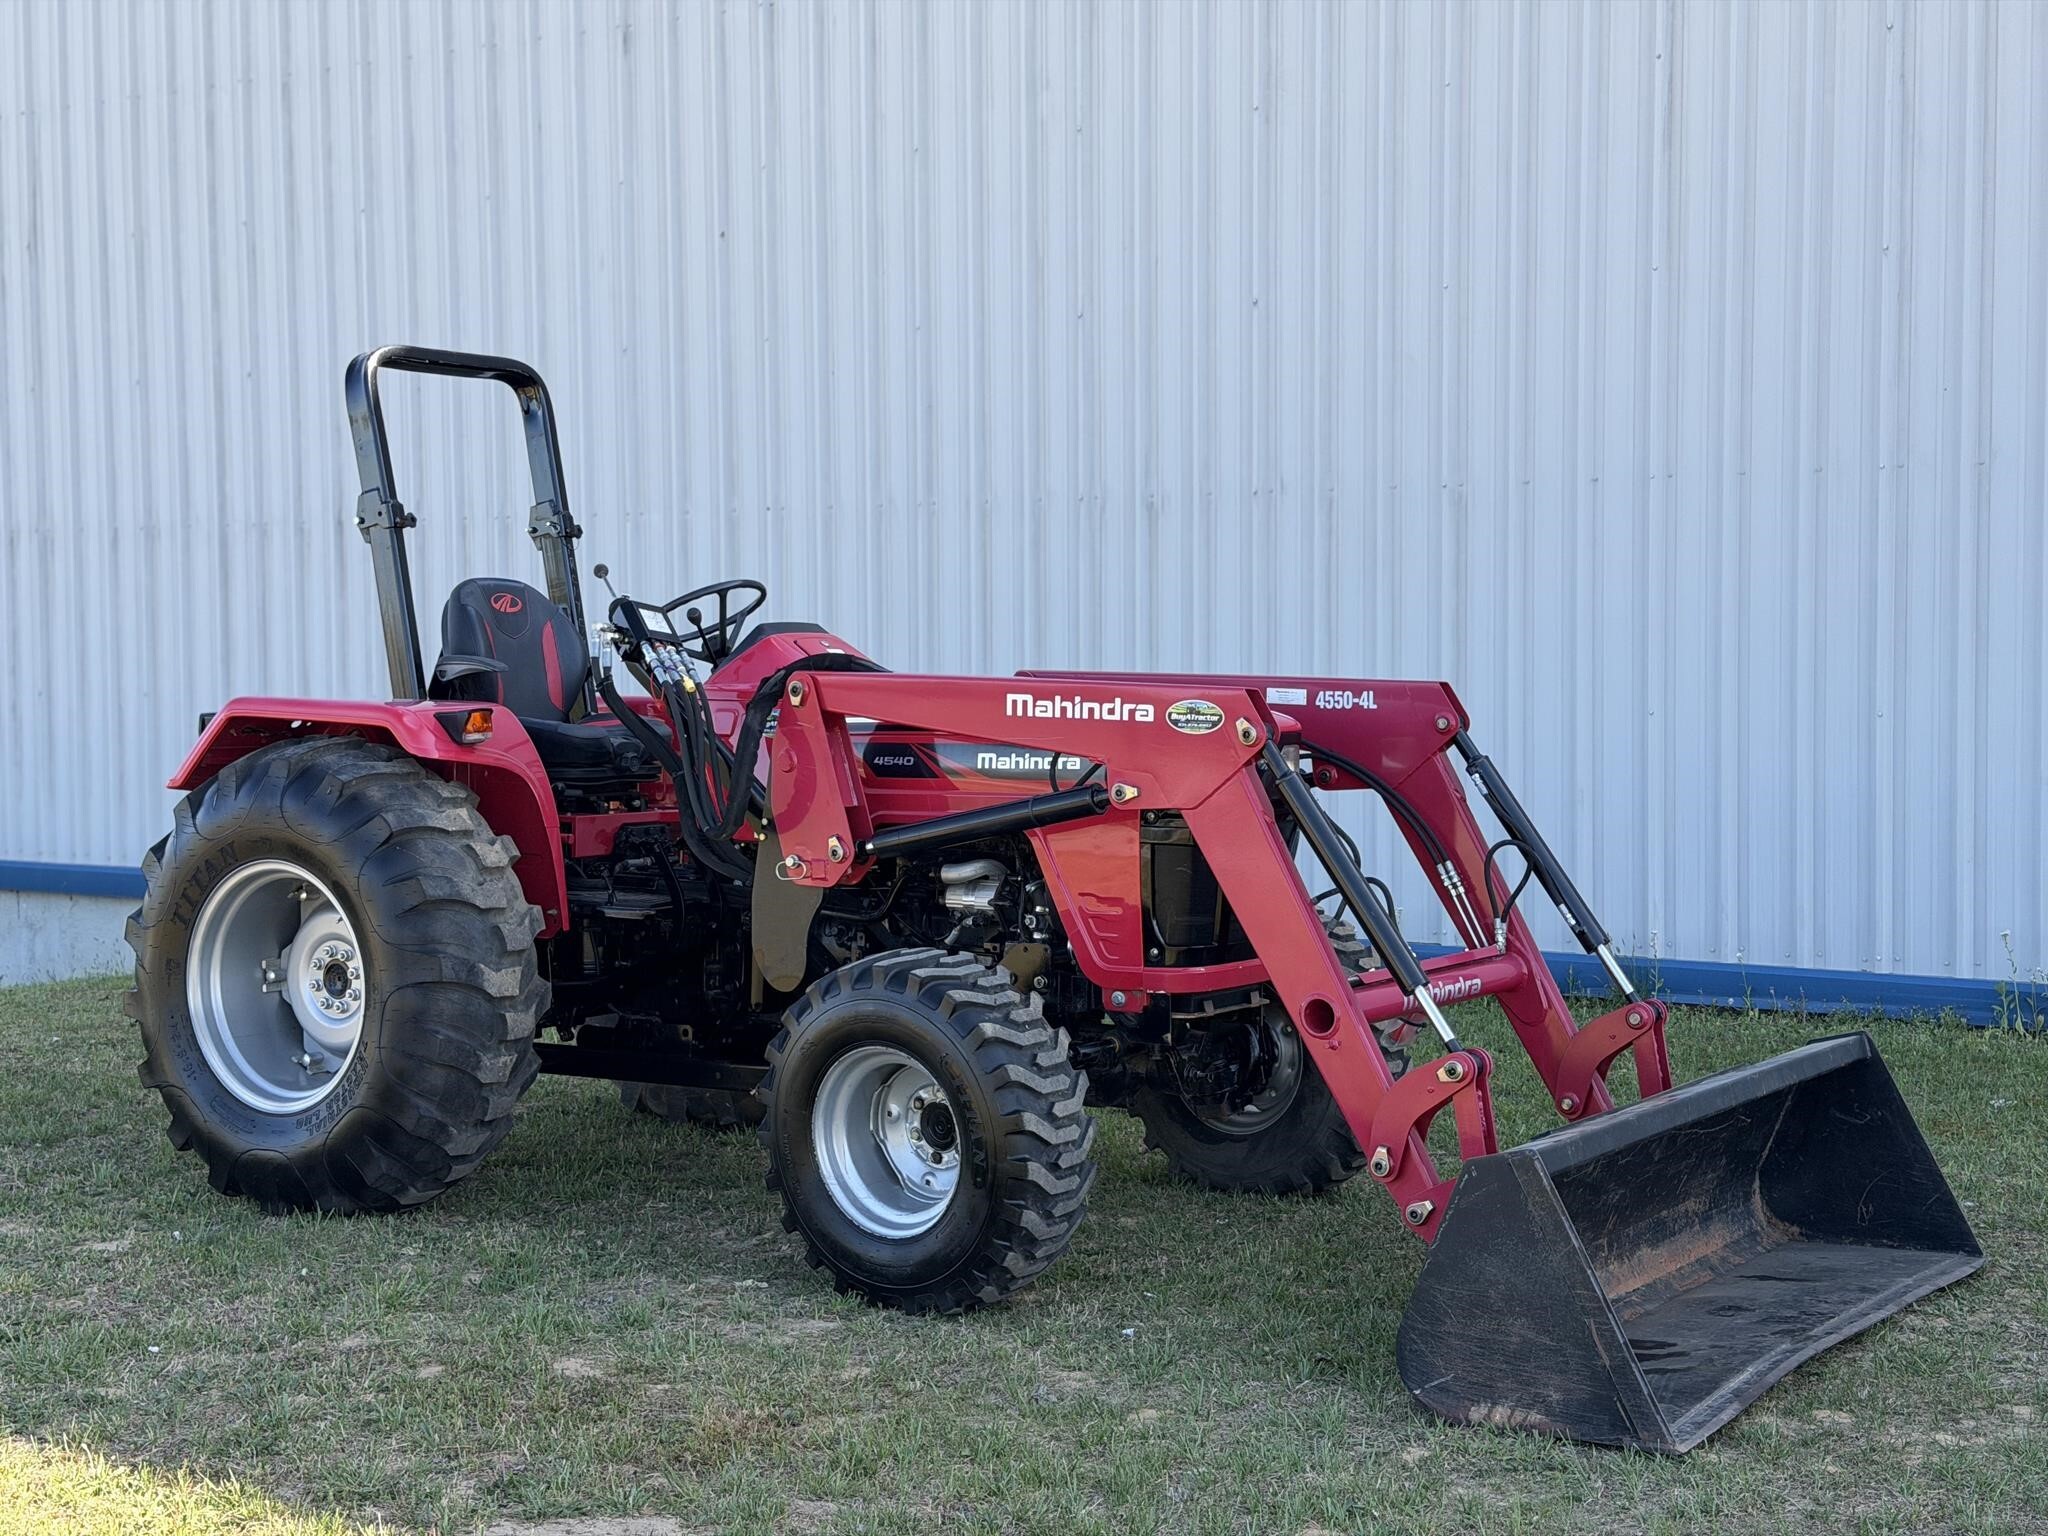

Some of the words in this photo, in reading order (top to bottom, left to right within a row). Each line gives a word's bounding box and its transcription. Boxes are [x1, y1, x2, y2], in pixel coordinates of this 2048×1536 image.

[1005, 692, 1155, 723] Mahindra
[1315, 690, 1378, 710] 4550-4L
[1170, 712, 1220, 722] BuyATractor
[872, 755, 915, 767] 4540
[174, 840, 239, 930] TITAN
